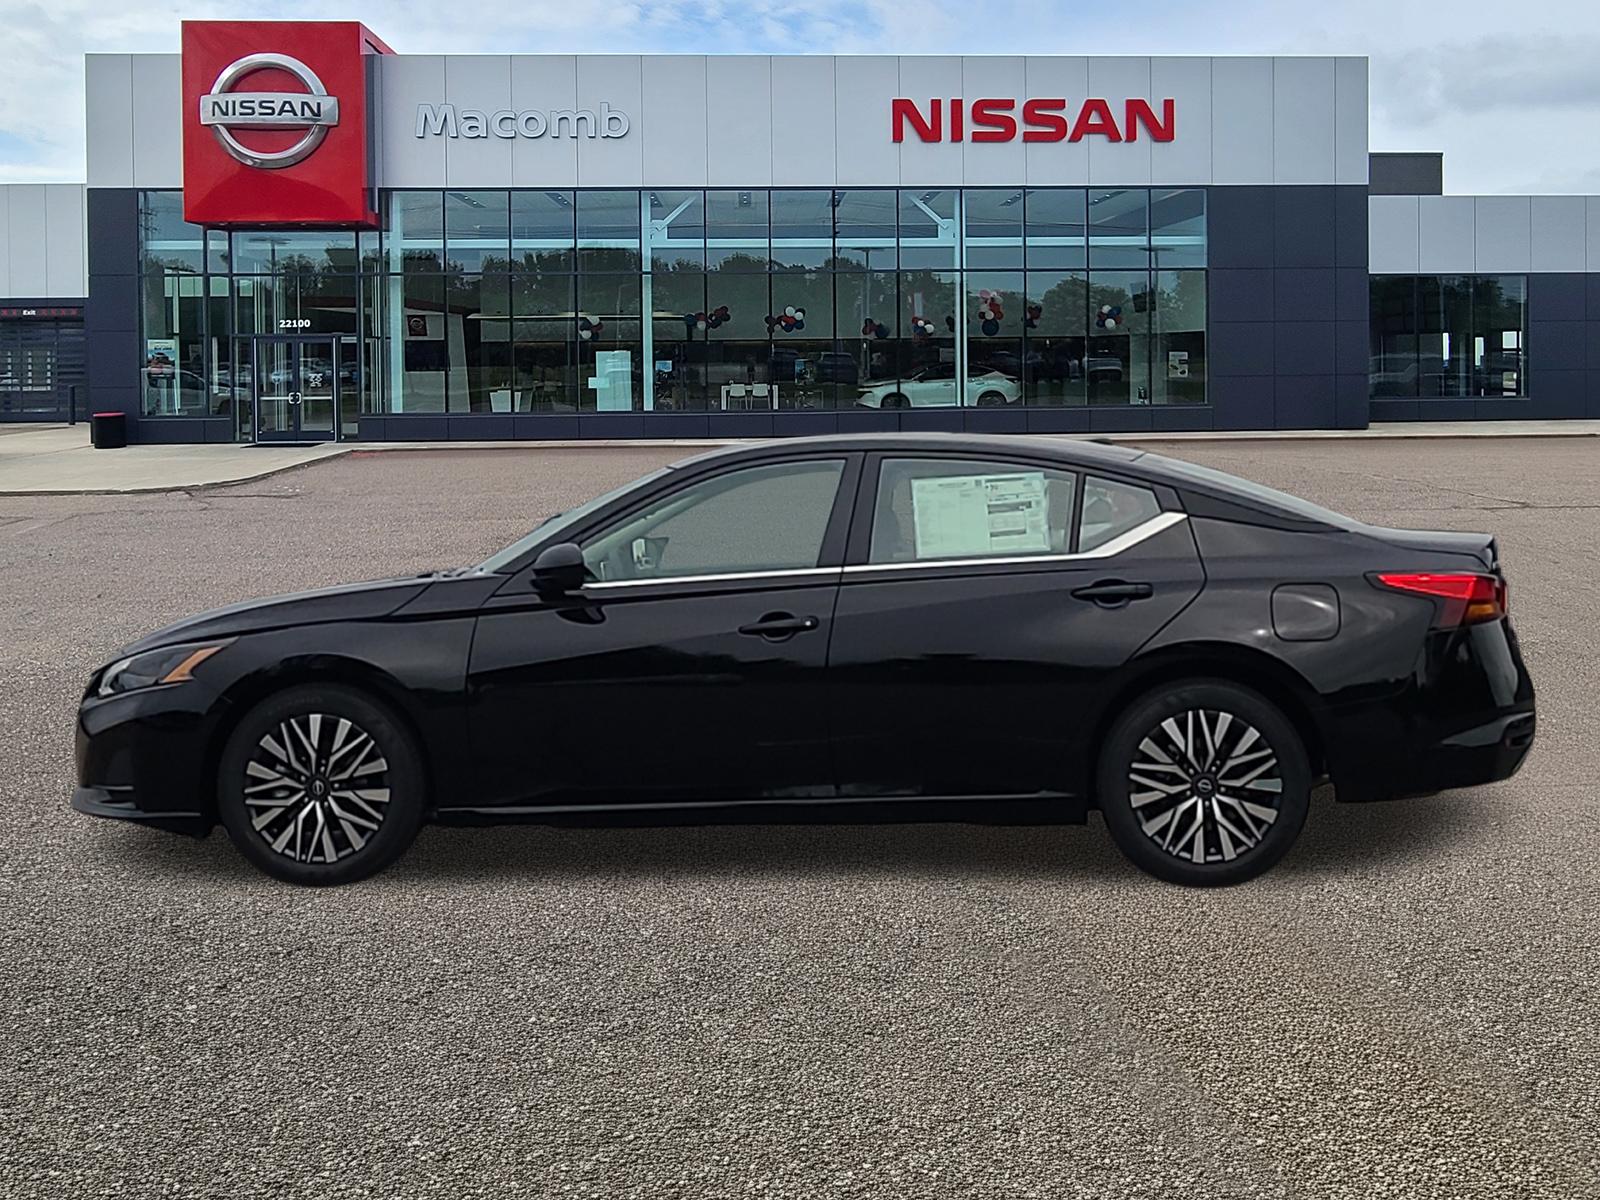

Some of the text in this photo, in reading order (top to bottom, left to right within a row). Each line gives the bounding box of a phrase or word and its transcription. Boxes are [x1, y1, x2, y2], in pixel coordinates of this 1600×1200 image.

[210, 99, 322, 118] NISSAN
[415, 101, 631, 139] Macomb
[892, 98, 1175, 143] NISSAN
[279, 319, 311, 328] 22100
